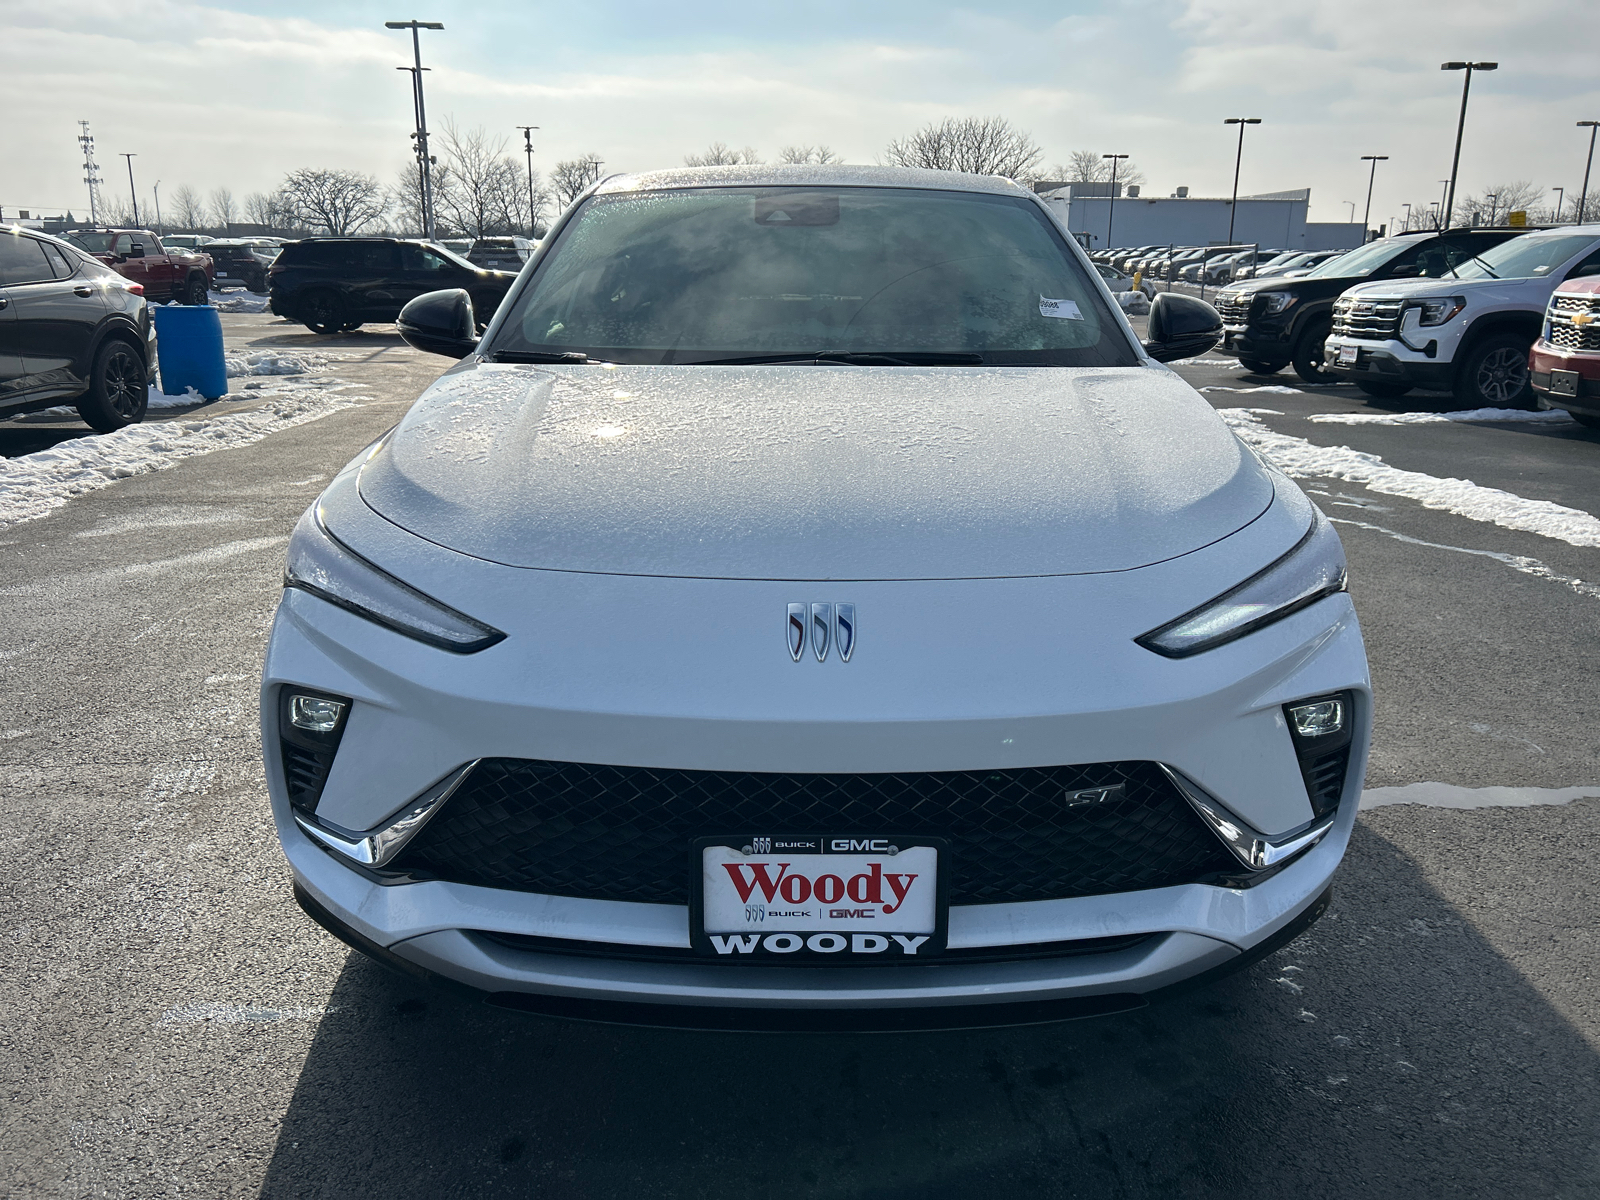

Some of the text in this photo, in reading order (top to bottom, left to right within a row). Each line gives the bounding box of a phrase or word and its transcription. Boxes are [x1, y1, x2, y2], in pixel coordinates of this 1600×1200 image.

[831, 839, 889, 851] GMC
[721, 863, 919, 914] Woody
[829, 908, 875, 919] GMC
[709, 933, 931, 955] WOODY
